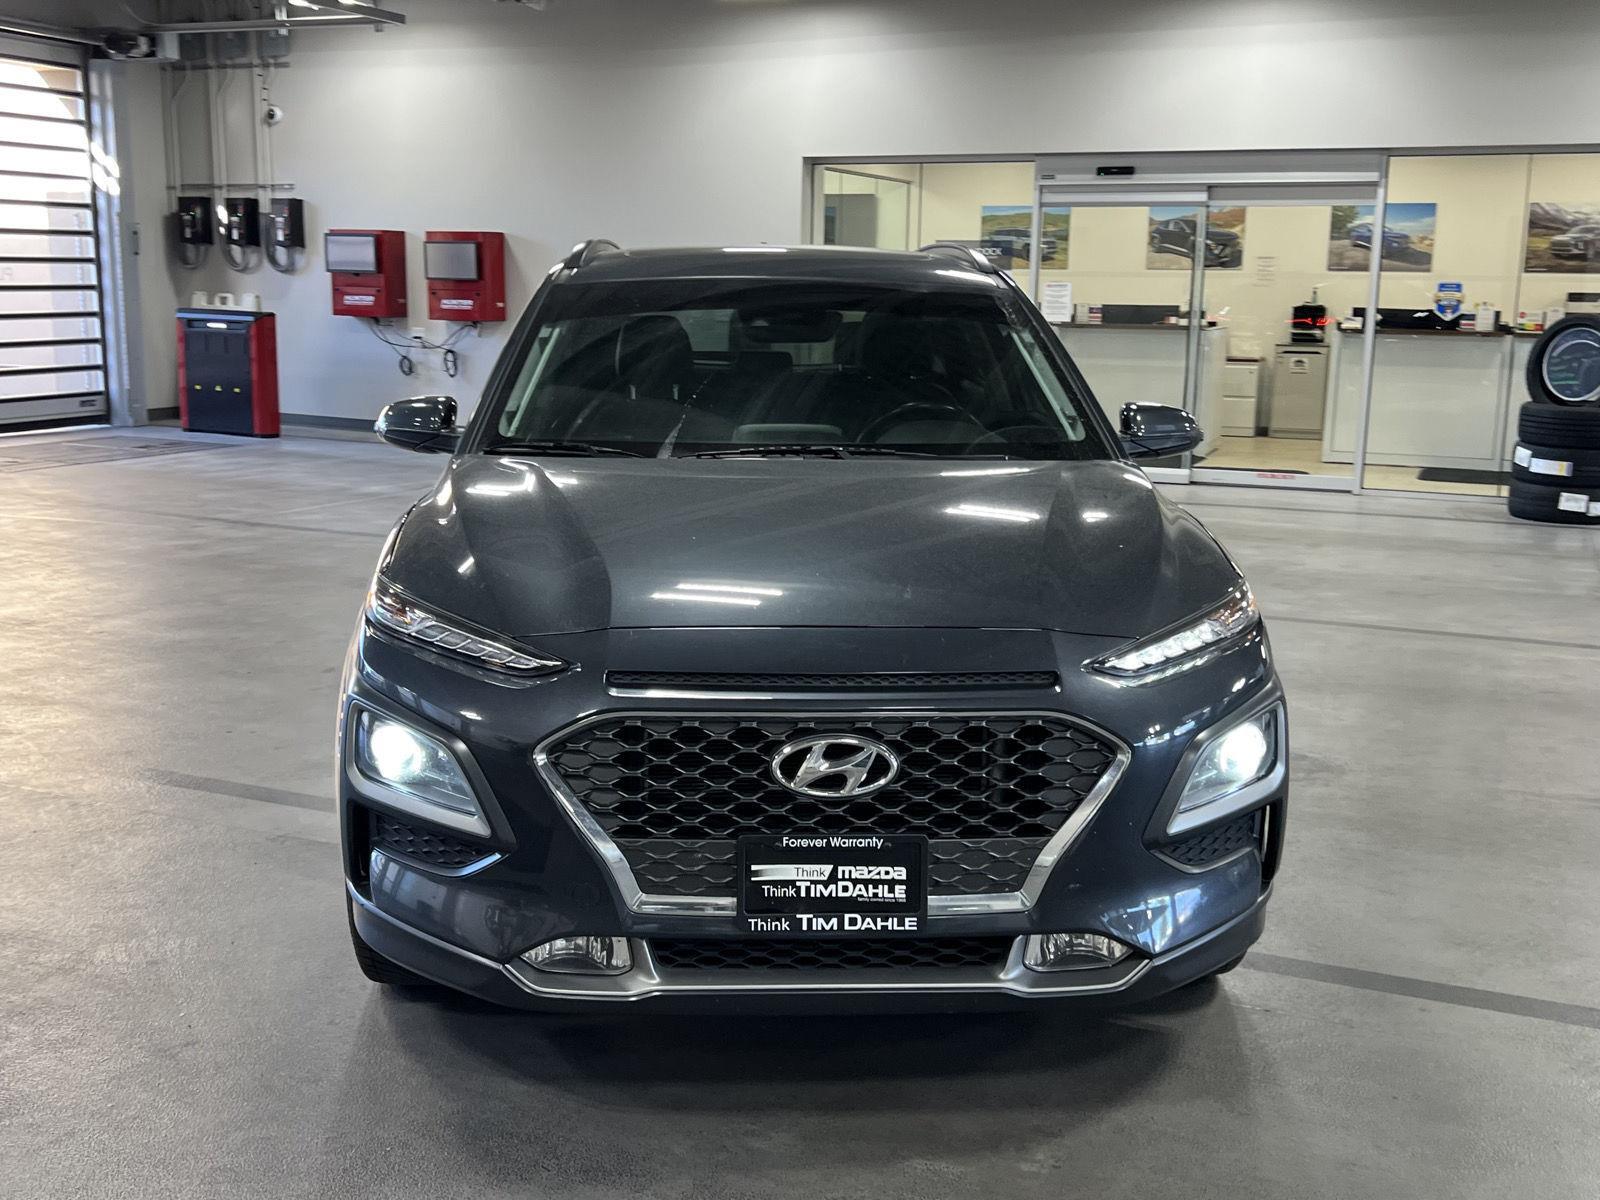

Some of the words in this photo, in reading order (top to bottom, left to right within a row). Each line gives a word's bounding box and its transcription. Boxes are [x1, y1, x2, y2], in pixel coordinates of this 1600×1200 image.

[782, 836, 828, 848] Forever
[829, 836, 884, 850] Warranty
[794, 866, 826, 878] Think
[762, 884, 796, 897] Think
[747, 918, 790, 931] Think
[796, 913, 838, 931] TIM
[843, 913, 918, 931] DAHLE
